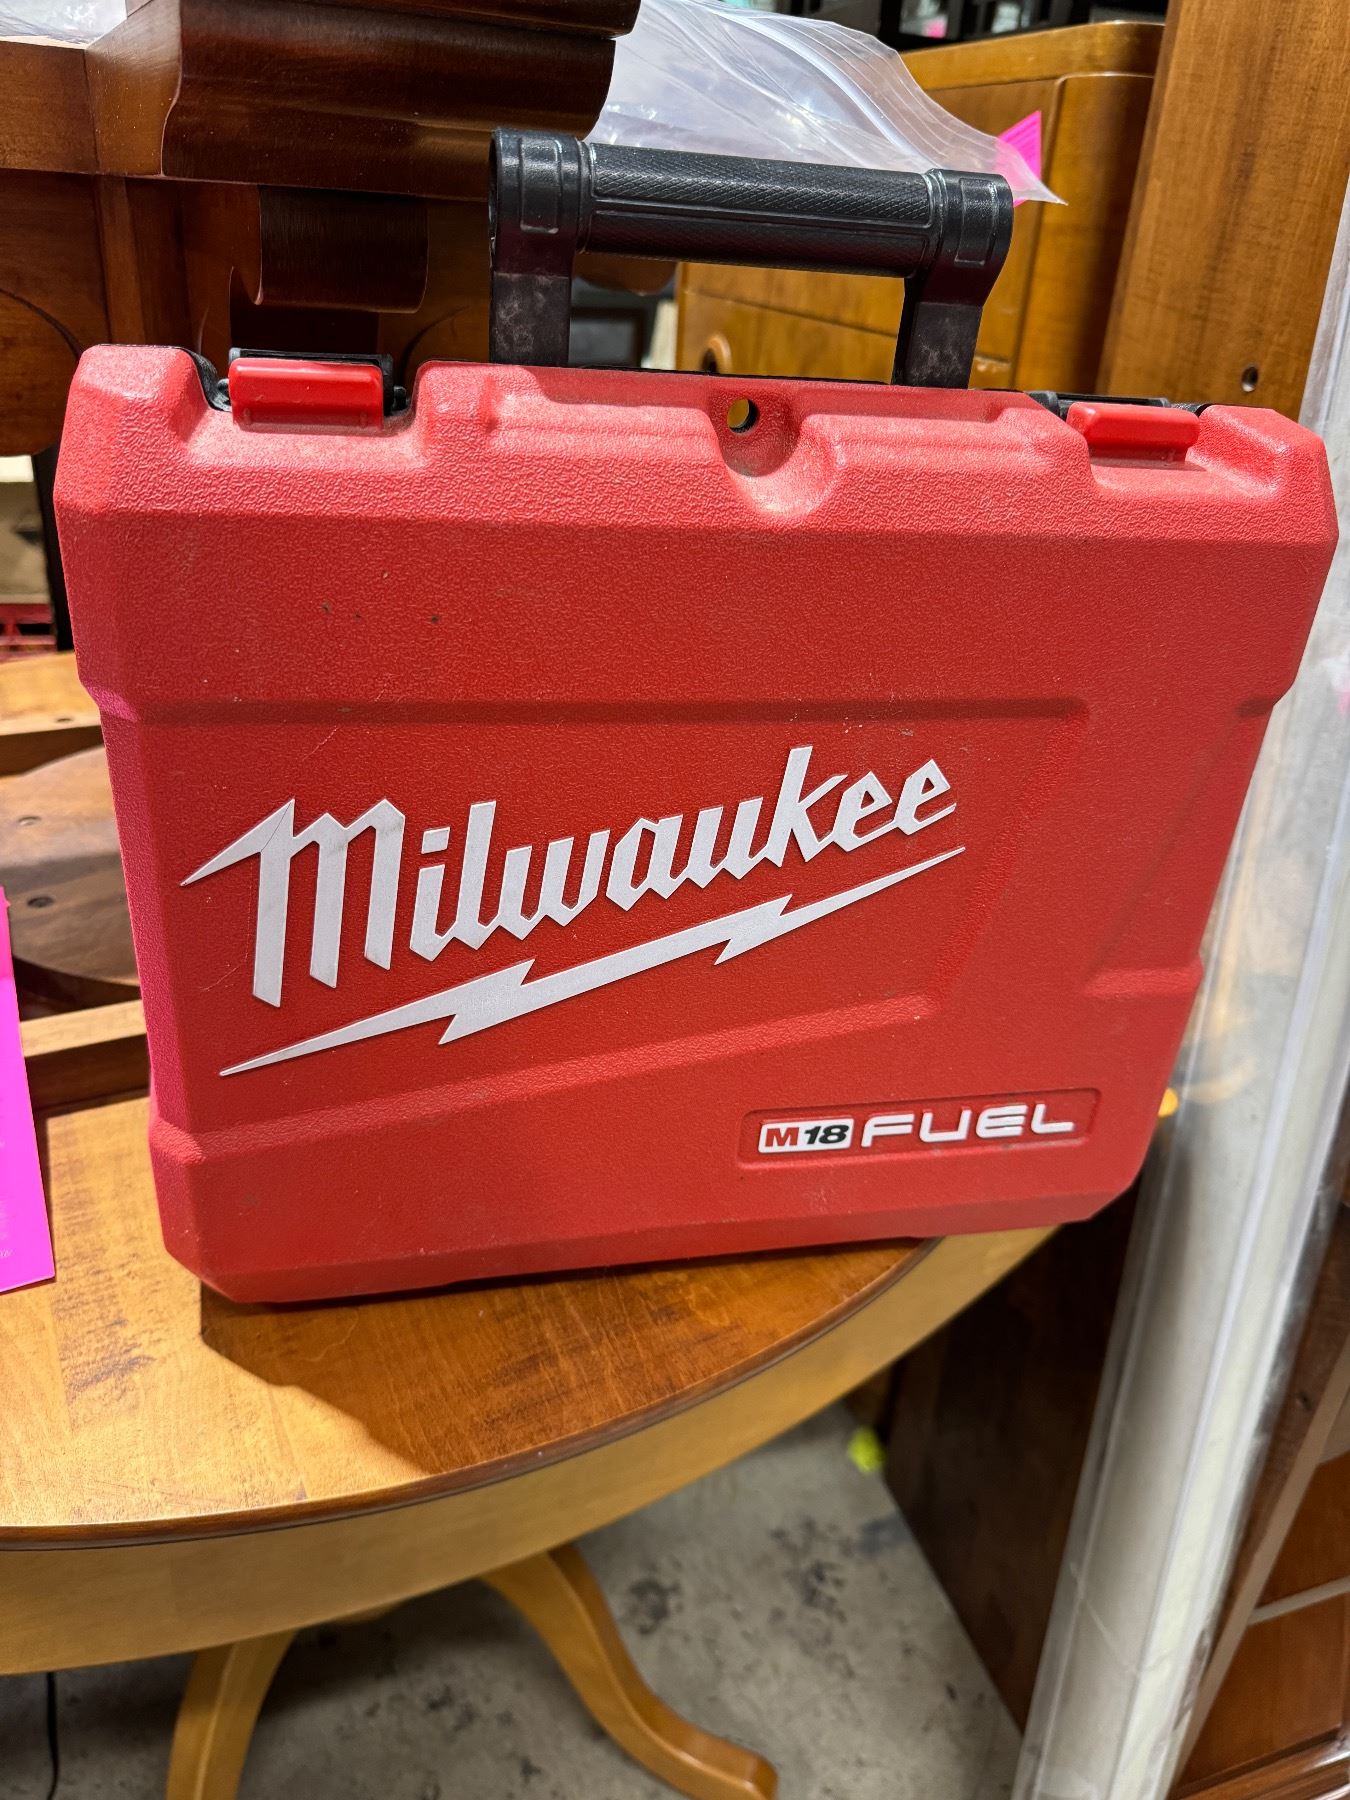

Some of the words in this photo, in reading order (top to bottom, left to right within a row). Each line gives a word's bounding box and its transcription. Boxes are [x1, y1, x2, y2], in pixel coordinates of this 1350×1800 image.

[180, 746, 957, 1008] Milwaukee
[763, 1123, 850, 1149] M18
[861, 1103, 1076, 1147] FUEL
